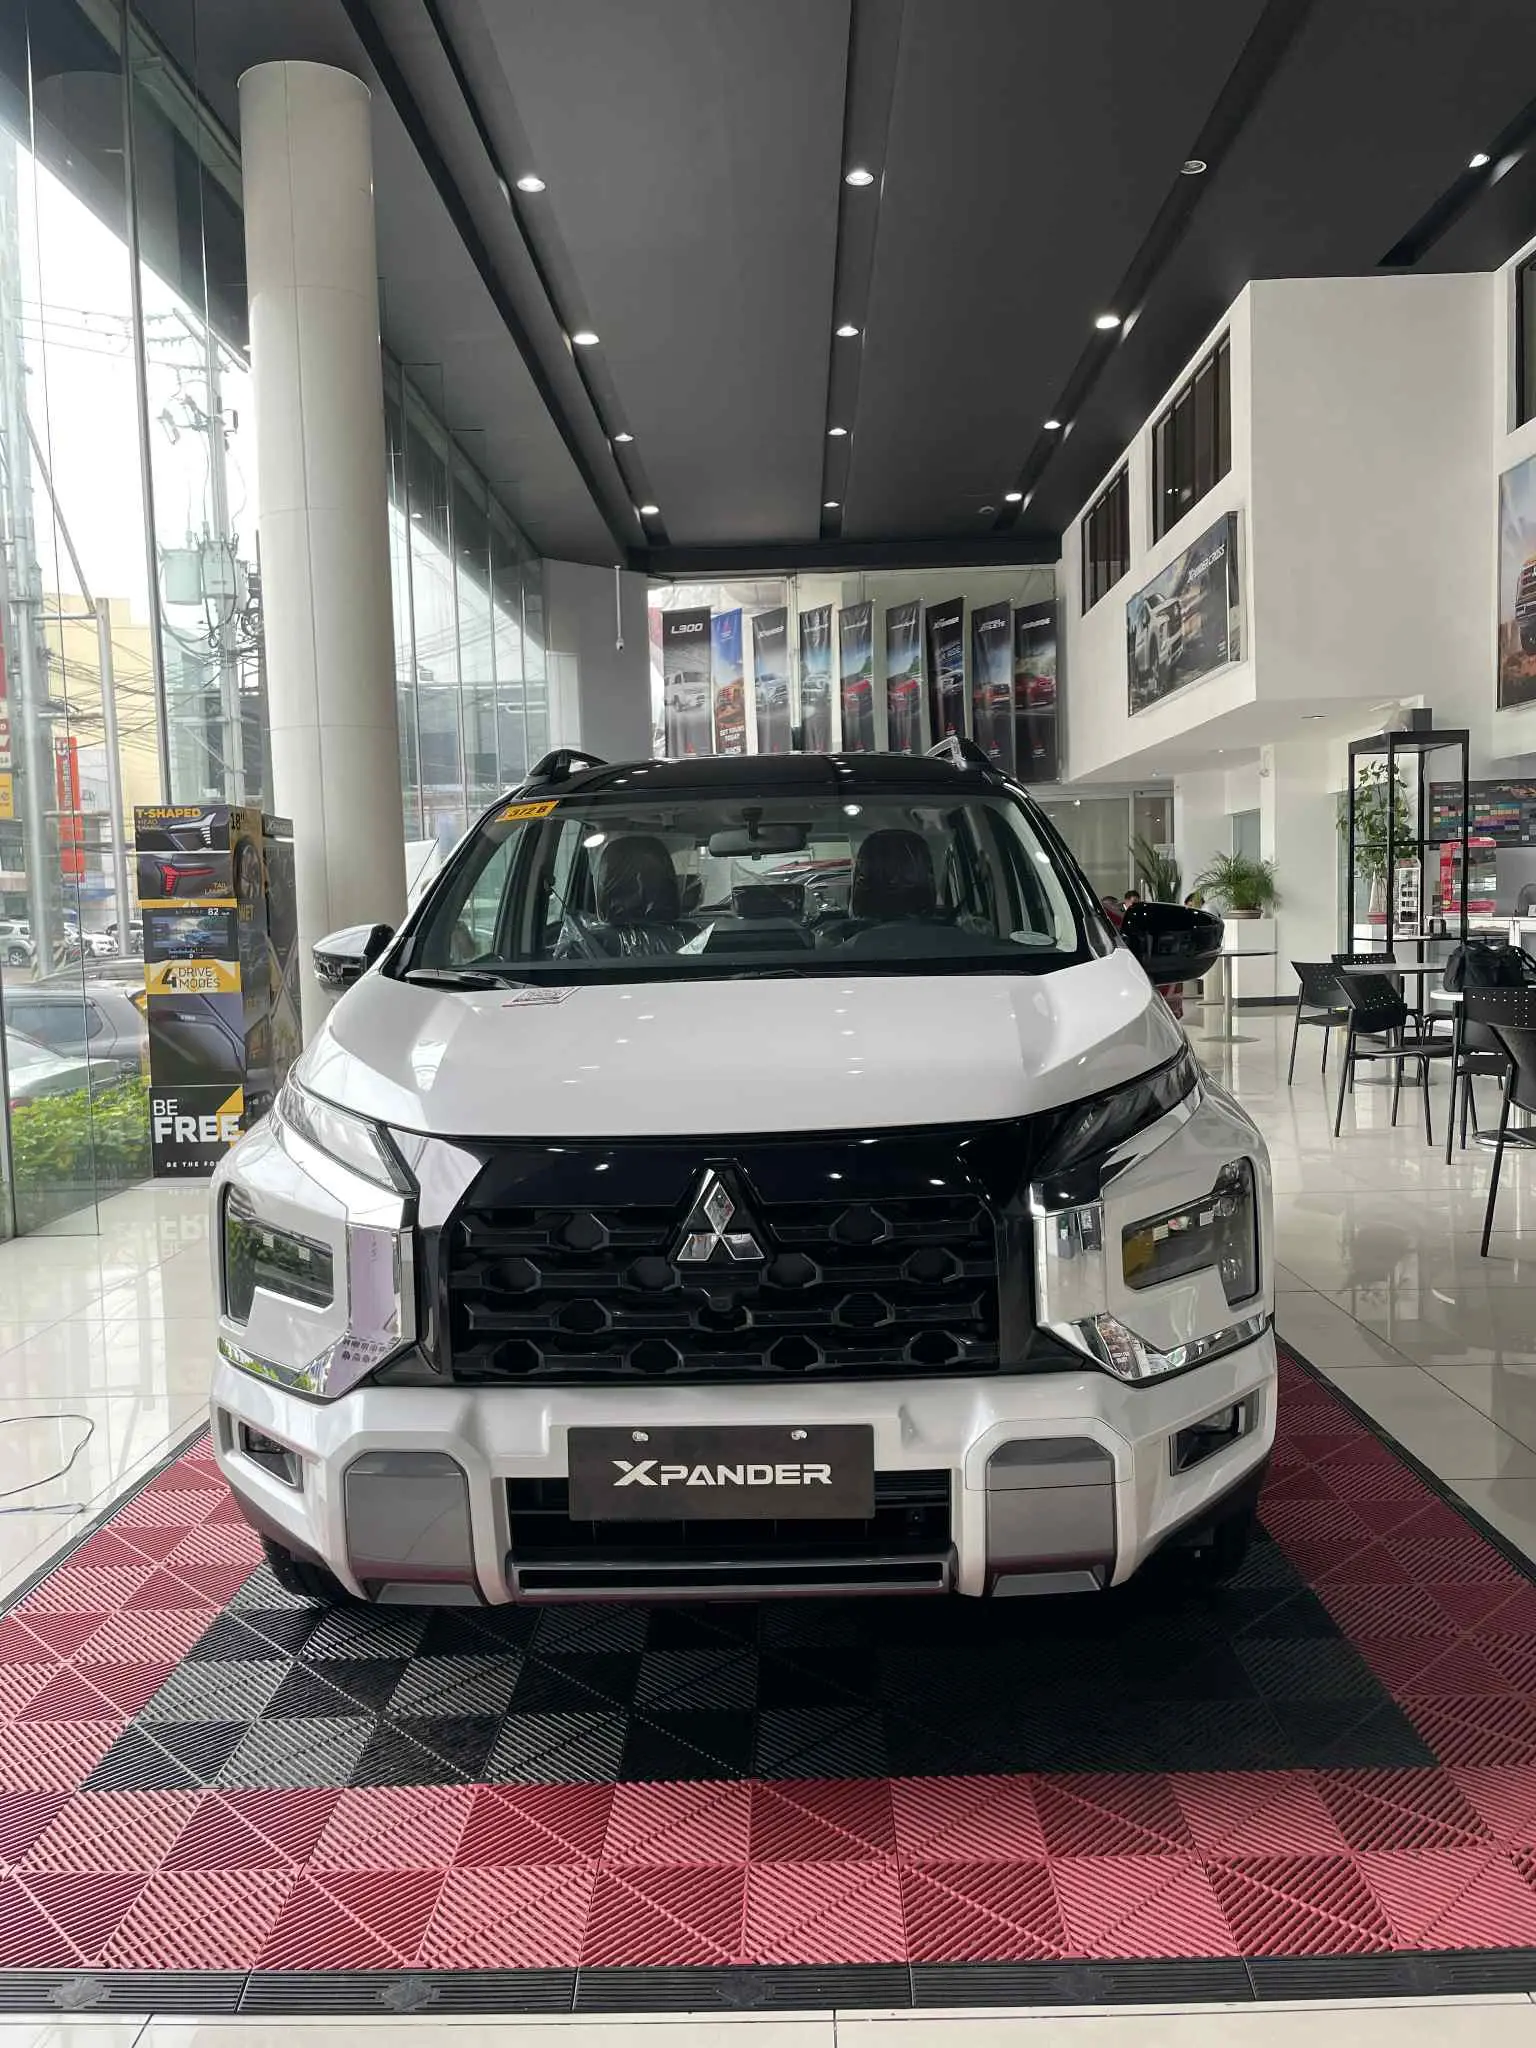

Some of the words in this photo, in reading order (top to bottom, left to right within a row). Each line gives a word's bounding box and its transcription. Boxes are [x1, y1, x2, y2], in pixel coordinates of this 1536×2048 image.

[671, 623, 704, 634] L300
[136, 807, 201, 819] T-SHAPED
[161, 968, 177, 988] 4
[179, 967, 212, 977] DRIVE
[179, 978, 221, 988] MODES
[153, 1098, 179, 1116] BE
[154, 1115, 241, 1144] FREE
[611, 1459, 833, 1487] XPANDER
